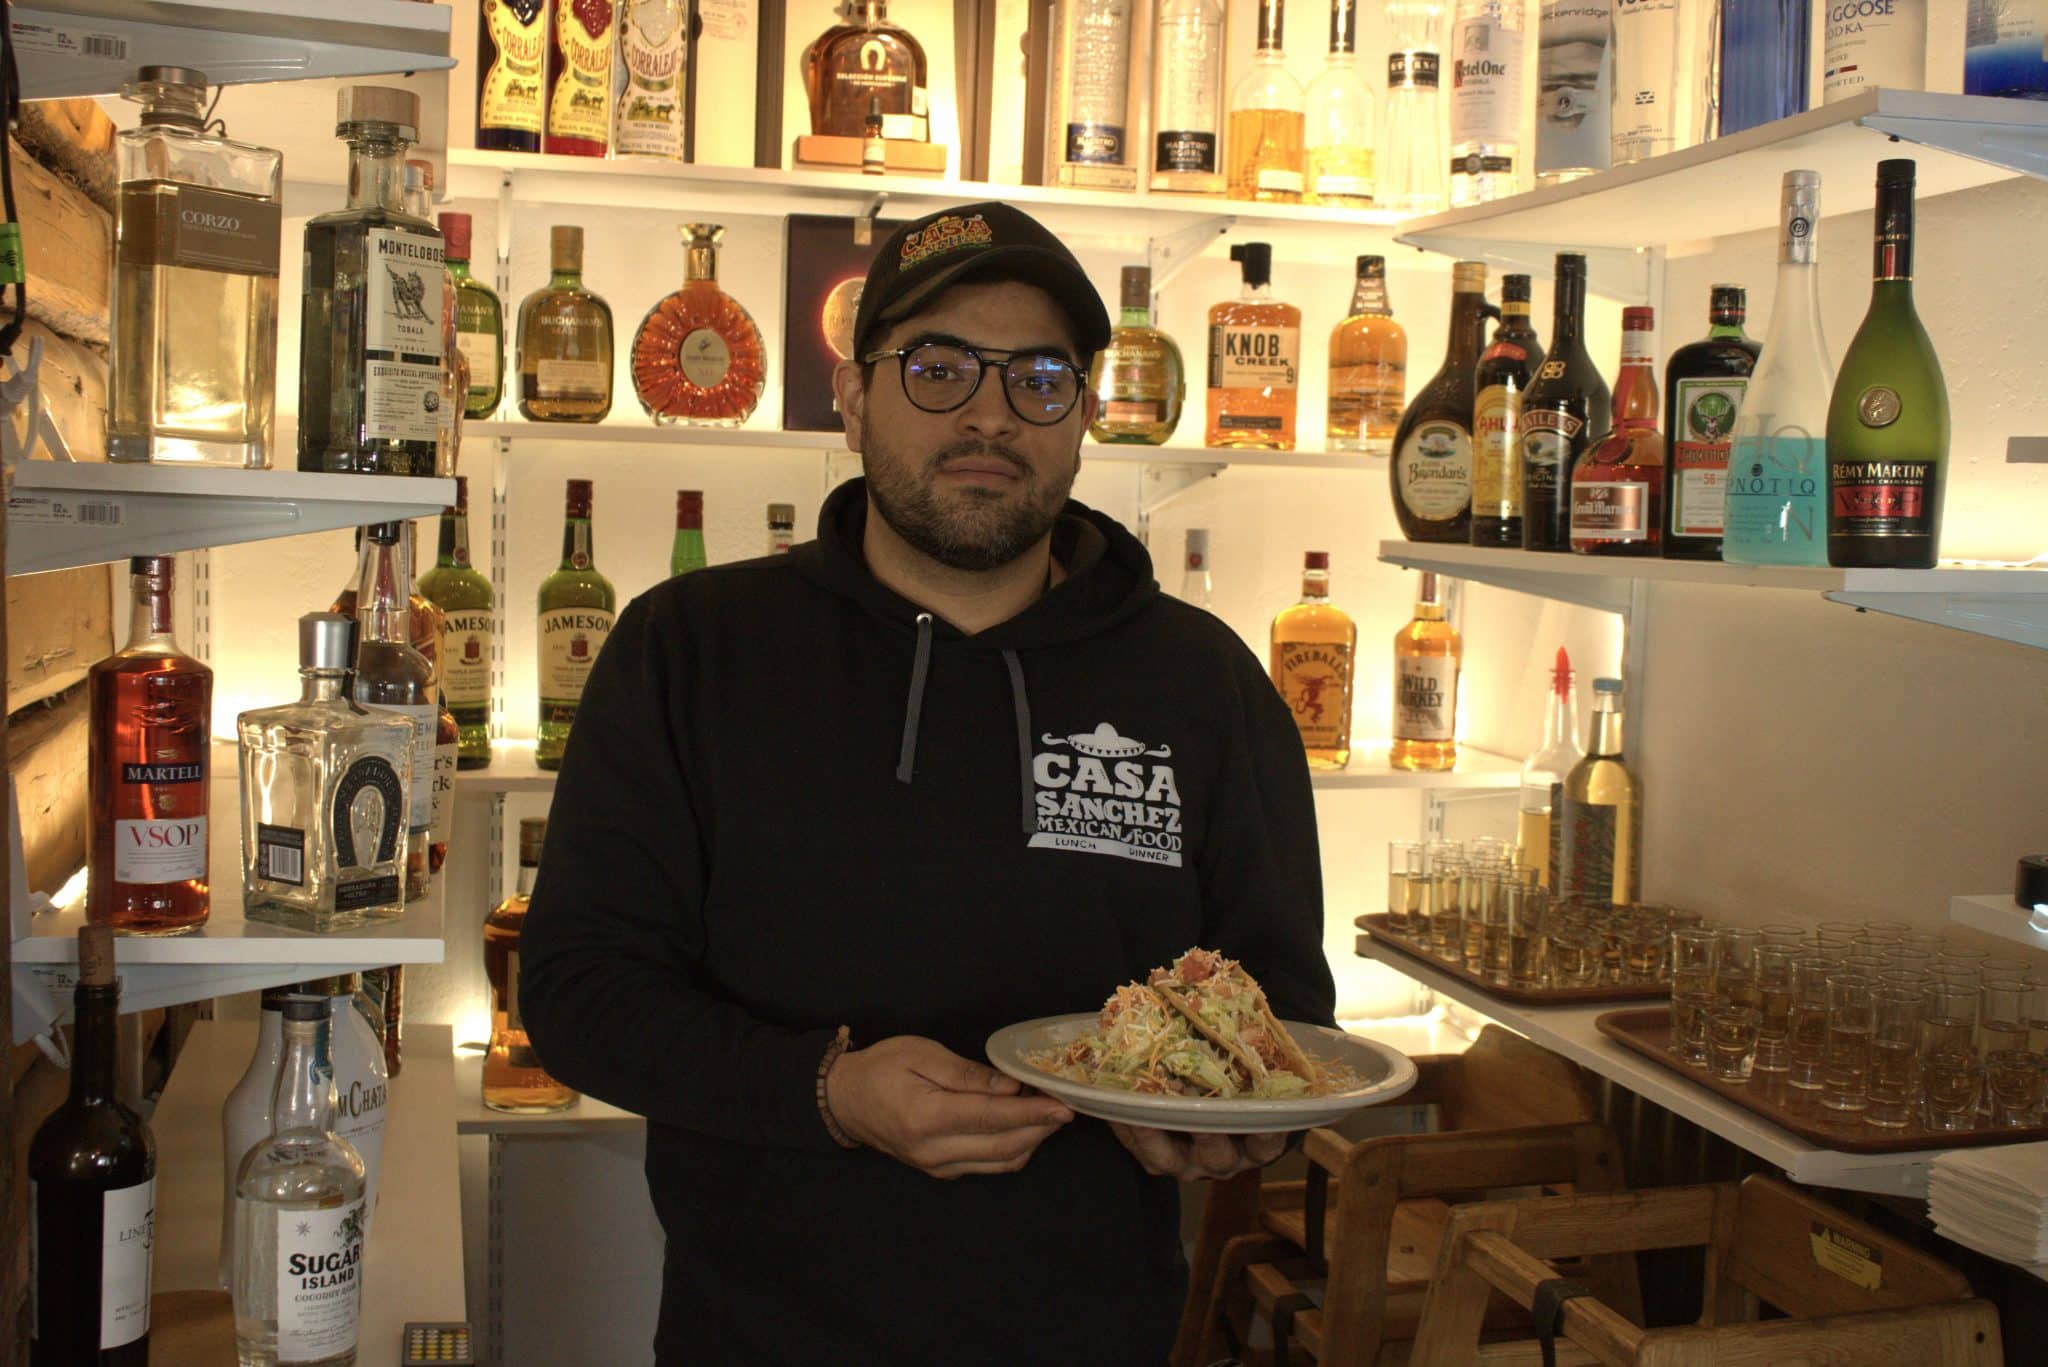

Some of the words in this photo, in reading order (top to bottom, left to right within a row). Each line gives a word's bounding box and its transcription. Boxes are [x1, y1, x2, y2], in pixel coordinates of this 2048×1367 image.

[1543, 7, 1609, 20] ckenridge
[1833, 0, 1896, 22] GOOSE
[1827, 22, 1863, 40] ODKA
[1482, 60, 1505, 76] One
[182, 209, 240, 232] CORZO
[902, 217, 993, 258] CASA
[378, 238, 445, 263] MONTELOBOS
[1226, 332, 1280, 357] KNOB
[1235, 356, 1289, 367] CREEK
[1286, 366, 1295, 384] 9
[1524, 411, 1577, 433] AILES
[1408, 463, 1468, 484] Brendan's
[1833, 463, 1864, 480] RÉMY
[1867, 462, 1925, 478] MARTIN
[1726, 477, 1817, 495] PNOTIQ
[445, 615, 491, 633] AMESO
[545, 614, 614, 634] JAMESON
[1401, 673, 1438, 691] WILD
[128, 765, 201, 781] MARTELL
[1033, 752, 1181, 806] CASA
[432, 775, 451, 793] rk
[1035, 790, 1182, 833] SANCHEZ
[129, 823, 199, 848] VSOP
[1036, 815, 1122, 841] MEXICAN
[1133, 827, 1182, 852] FOOD
[1055, 836, 1097, 850] LUNCH
[1128, 847, 1169, 863] DINNER
[288, 1243, 360, 1276] SUGAR
[301, 1267, 355, 1290] ISLAND
